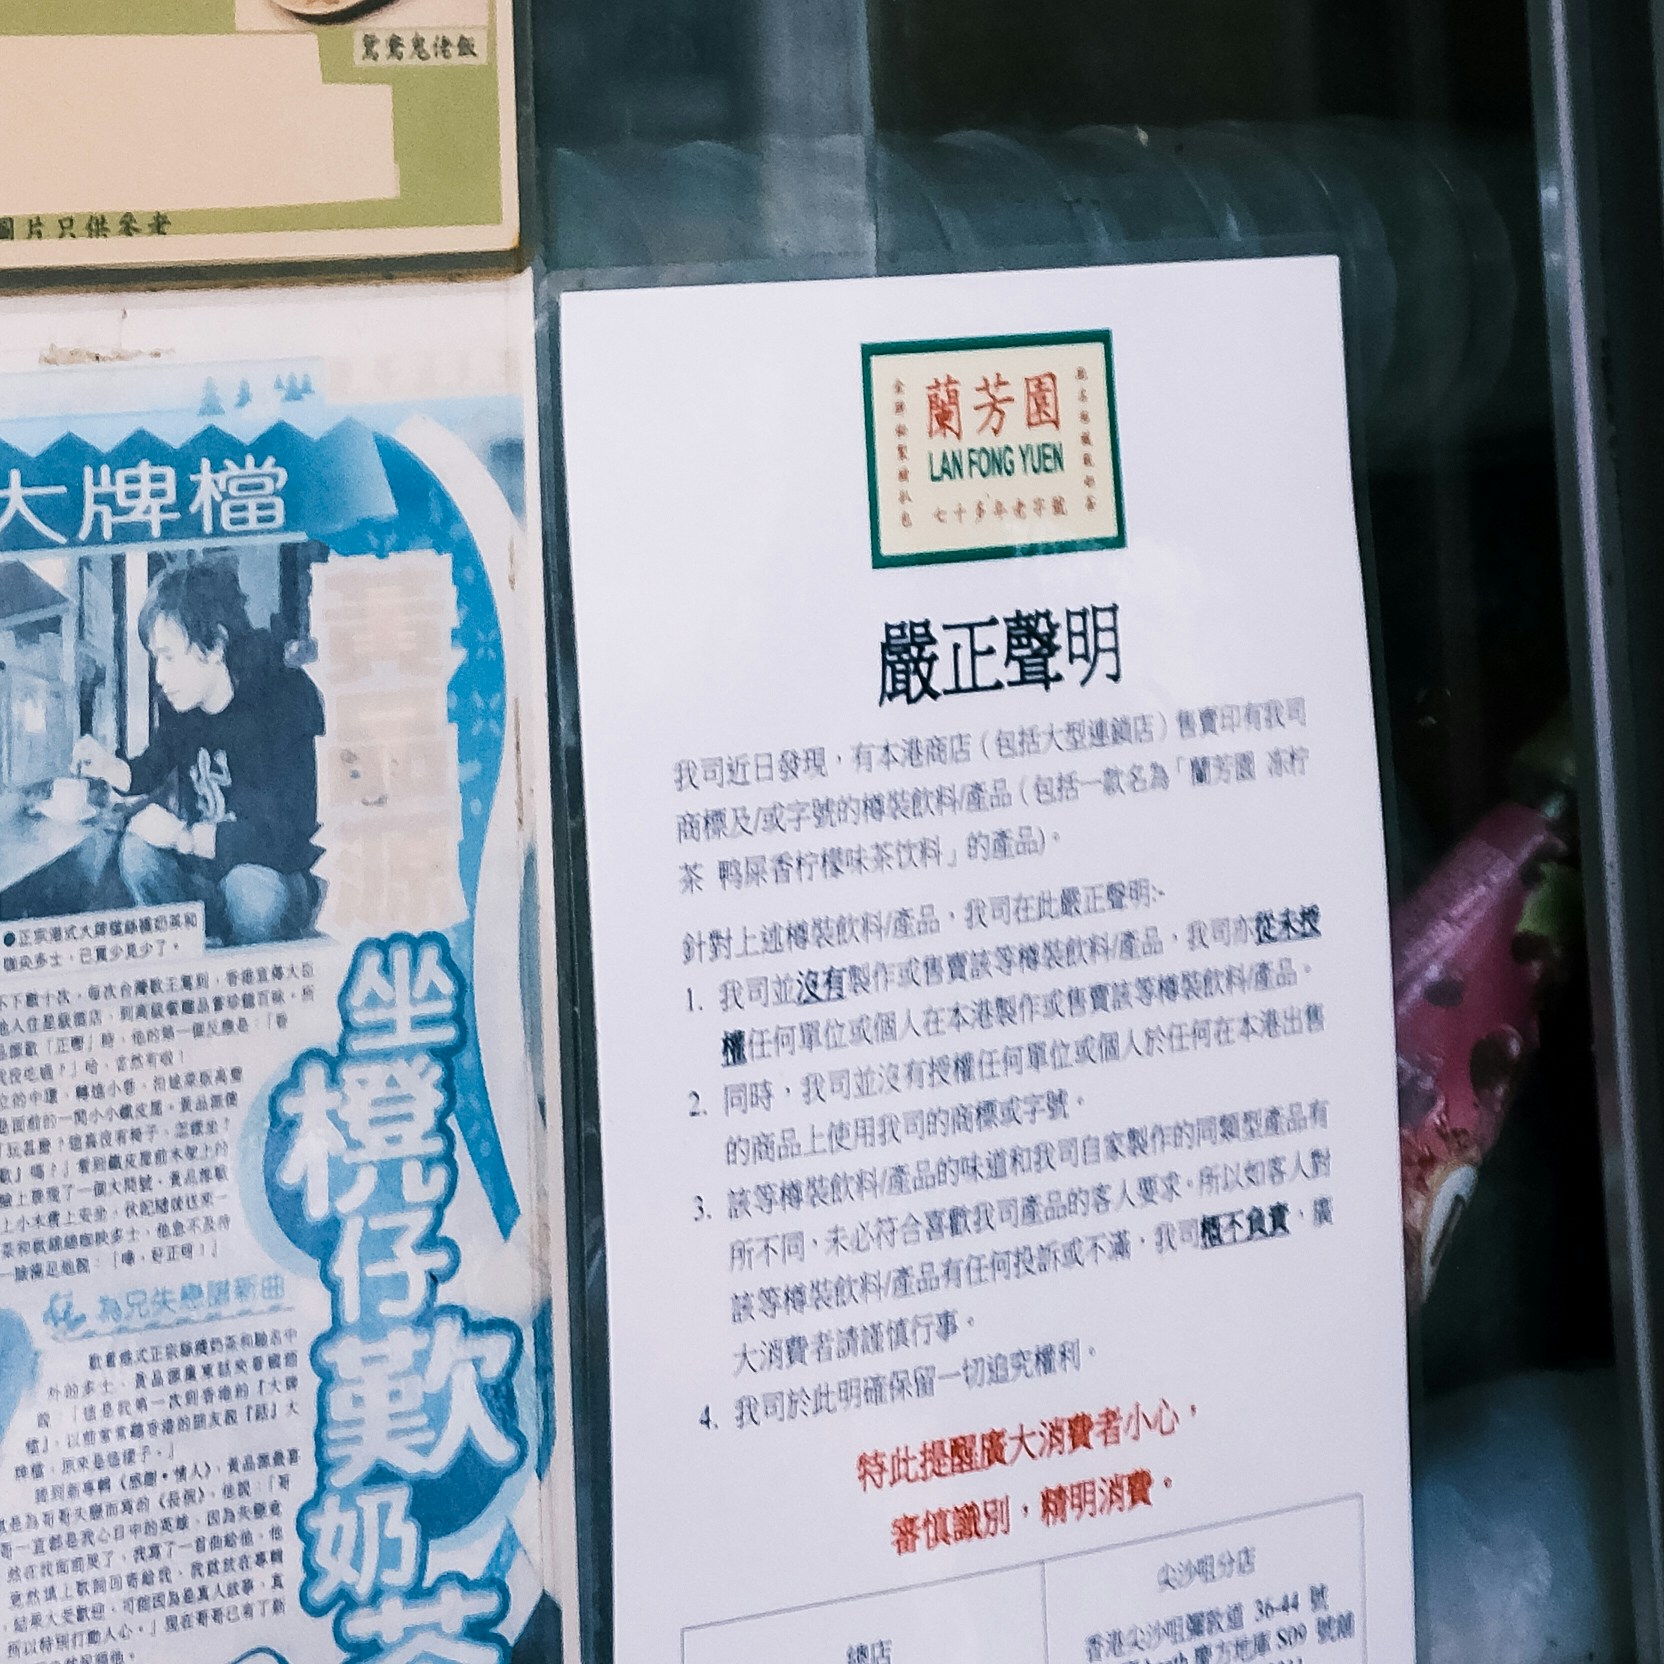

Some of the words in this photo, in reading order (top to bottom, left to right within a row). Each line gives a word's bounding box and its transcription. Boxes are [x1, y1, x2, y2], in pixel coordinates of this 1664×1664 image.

[925, 371, 1062, 441] 蘭芳園
[927, 448, 966, 483] LAN
[968, 443, 1016, 479] FONG
[1019, 440, 1066, 475] YUEN
[877, 601, 1123, 708] 嚴正聲明
[679, 860, 704, 895] 茶
[687, 987, 704, 1013] 1.
[688, 1089, 708, 1118] 2.
[693, 1194, 713, 1222] 3.
